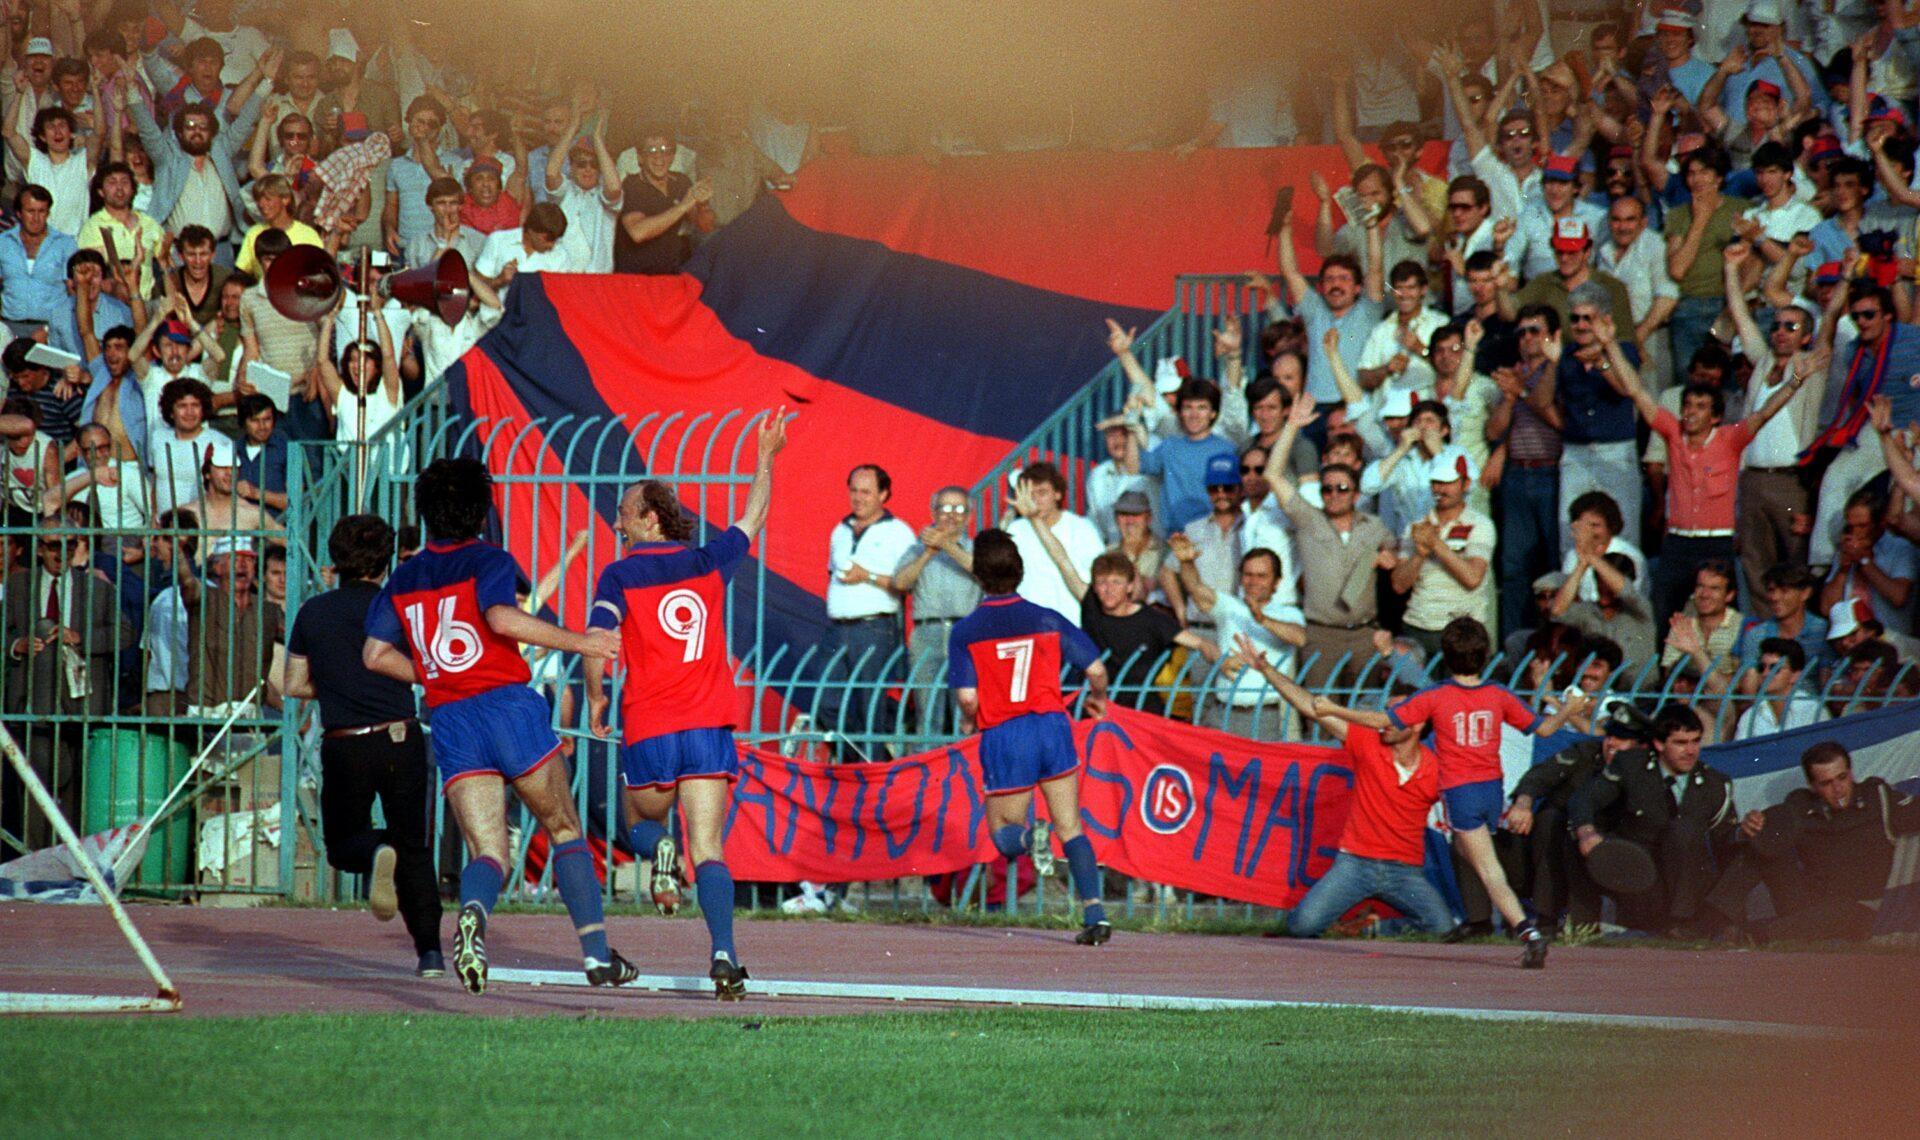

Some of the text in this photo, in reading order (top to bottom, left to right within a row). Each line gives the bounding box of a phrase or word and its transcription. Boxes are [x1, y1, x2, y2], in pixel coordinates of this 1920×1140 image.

[405, 595, 484, 679] 16
[657, 588, 708, 663] 9
[996, 638, 1034, 702] 7
[1452, 710, 1493, 747] 10
[1154, 779, 1182, 819] IS
